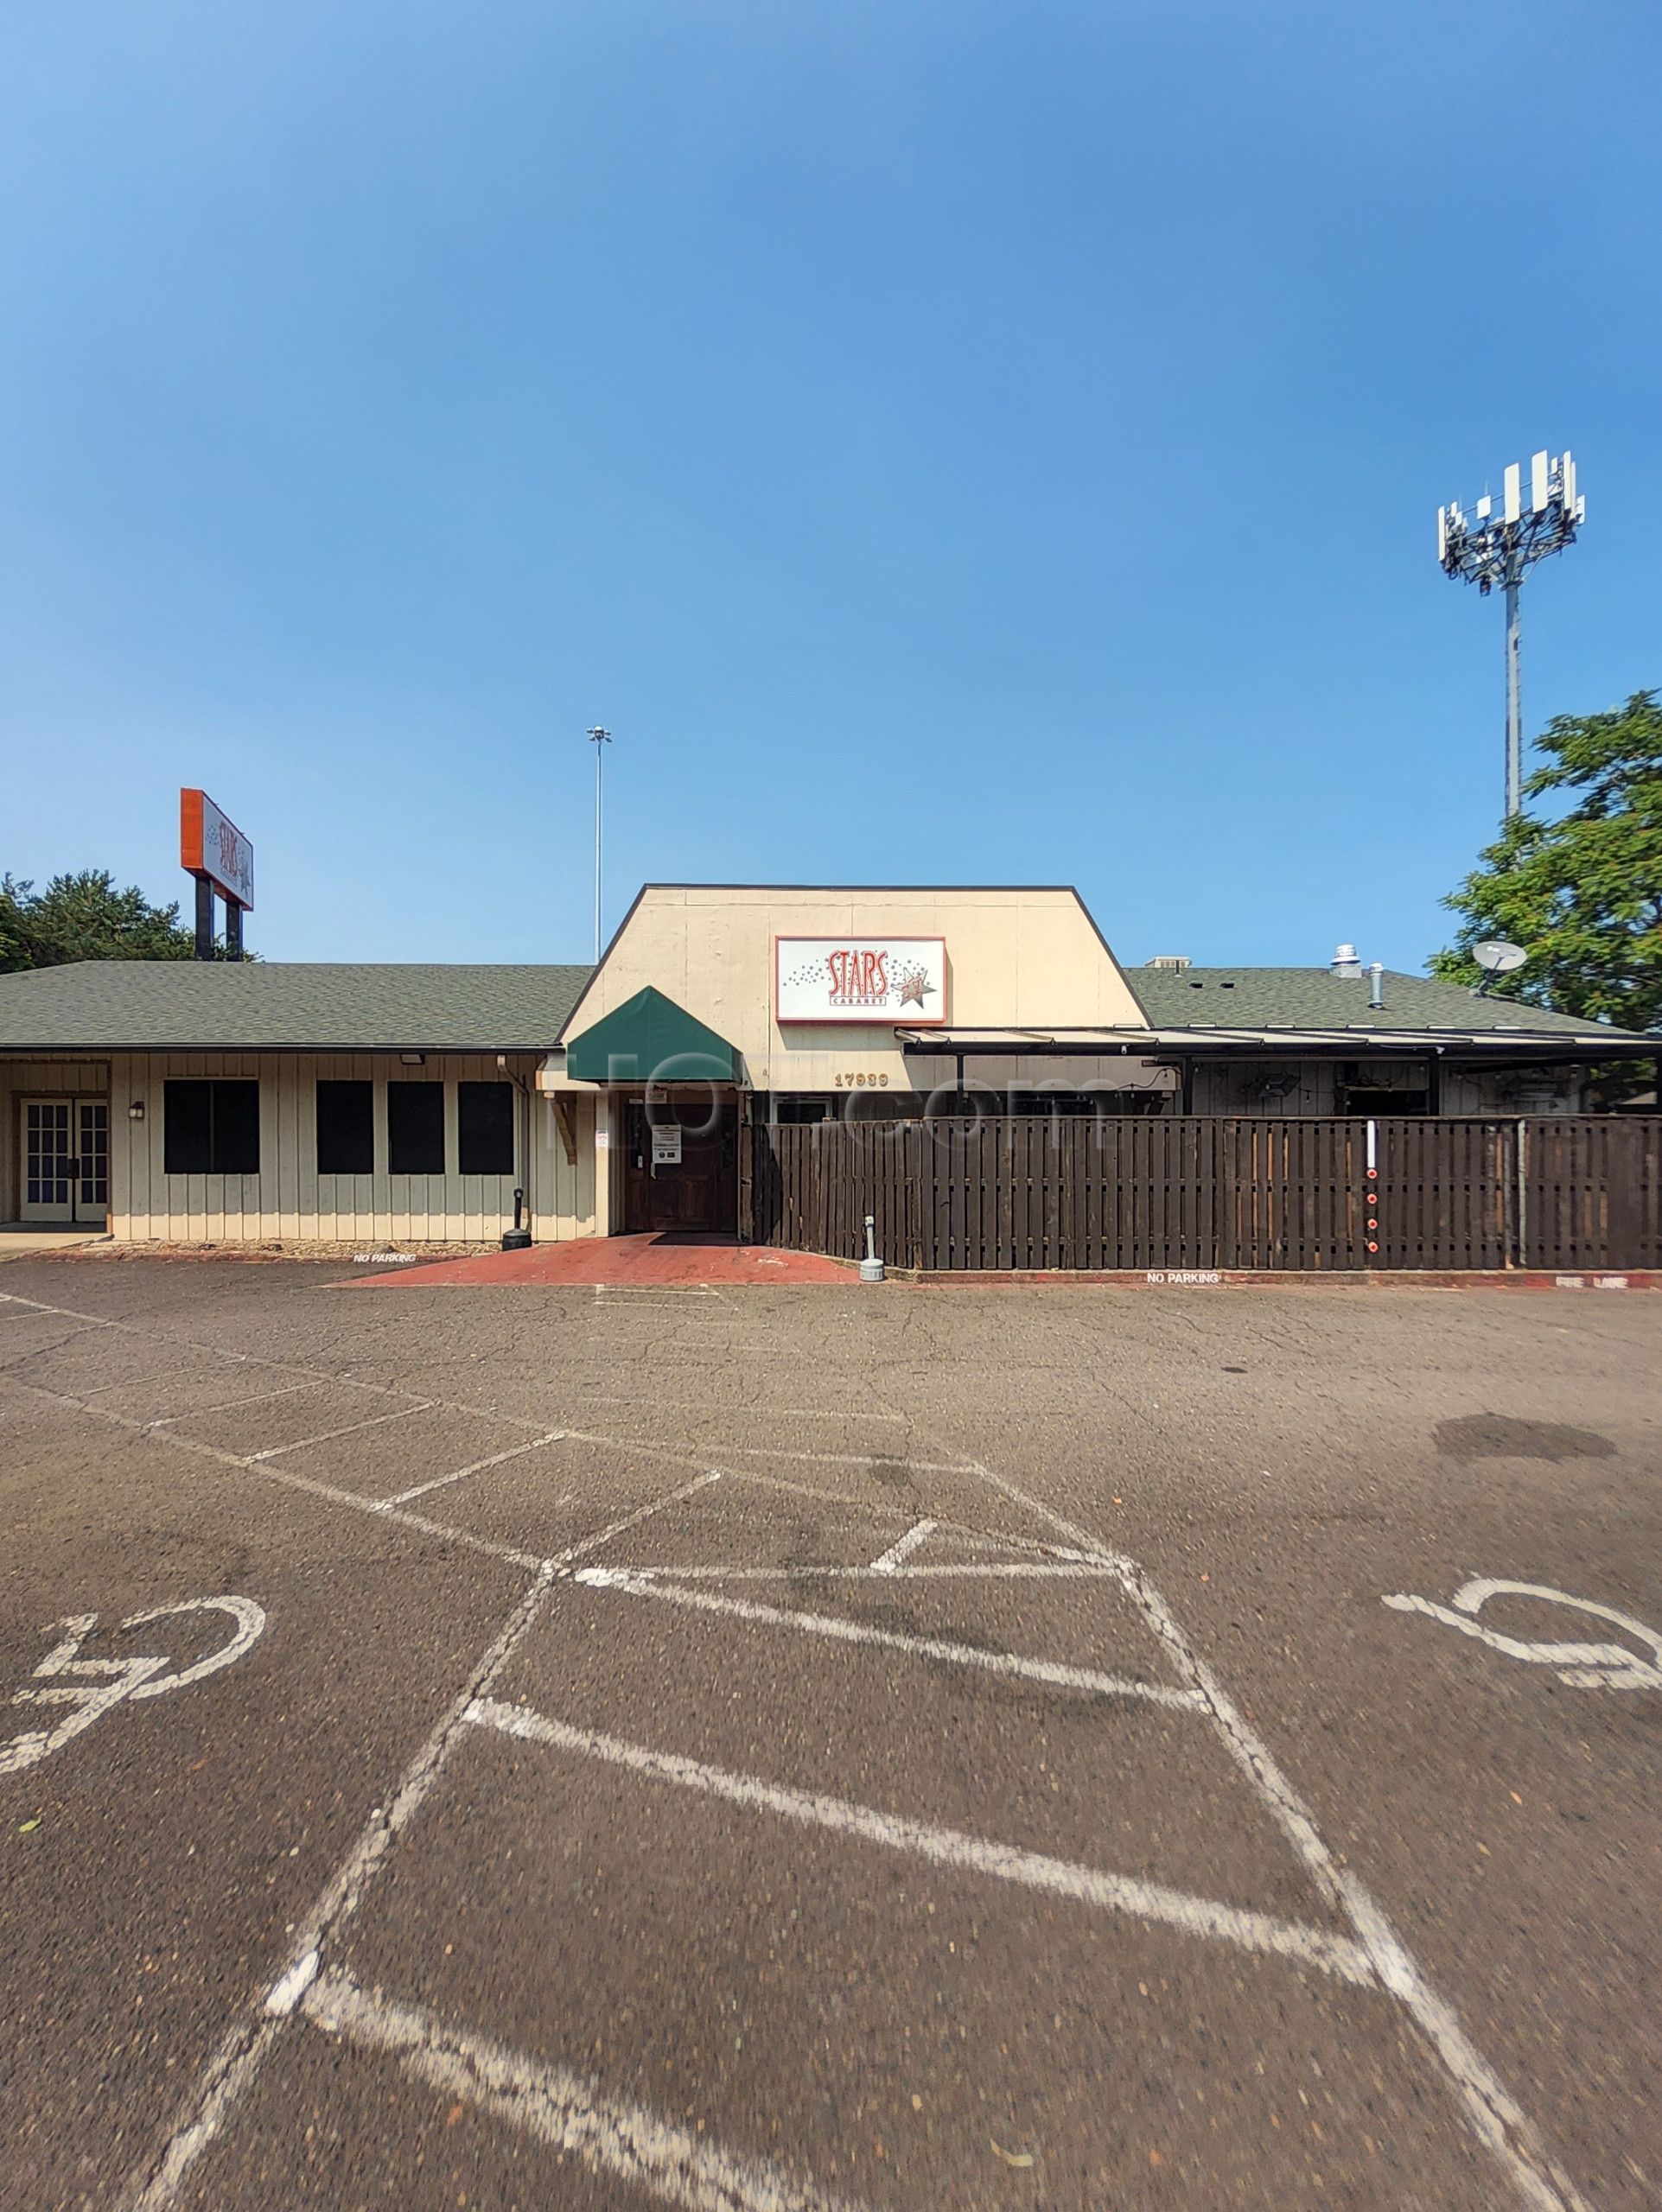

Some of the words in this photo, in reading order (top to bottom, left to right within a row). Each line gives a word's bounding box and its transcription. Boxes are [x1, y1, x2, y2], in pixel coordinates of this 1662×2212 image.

[828, 950, 888, 996] STARS
[353, 1254, 370, 1262] NO
[371, 1253, 417, 1263] PARKING
[1147, 1273, 1164, 1283] NO
[1168, 1273, 1219, 1283] PARKING
